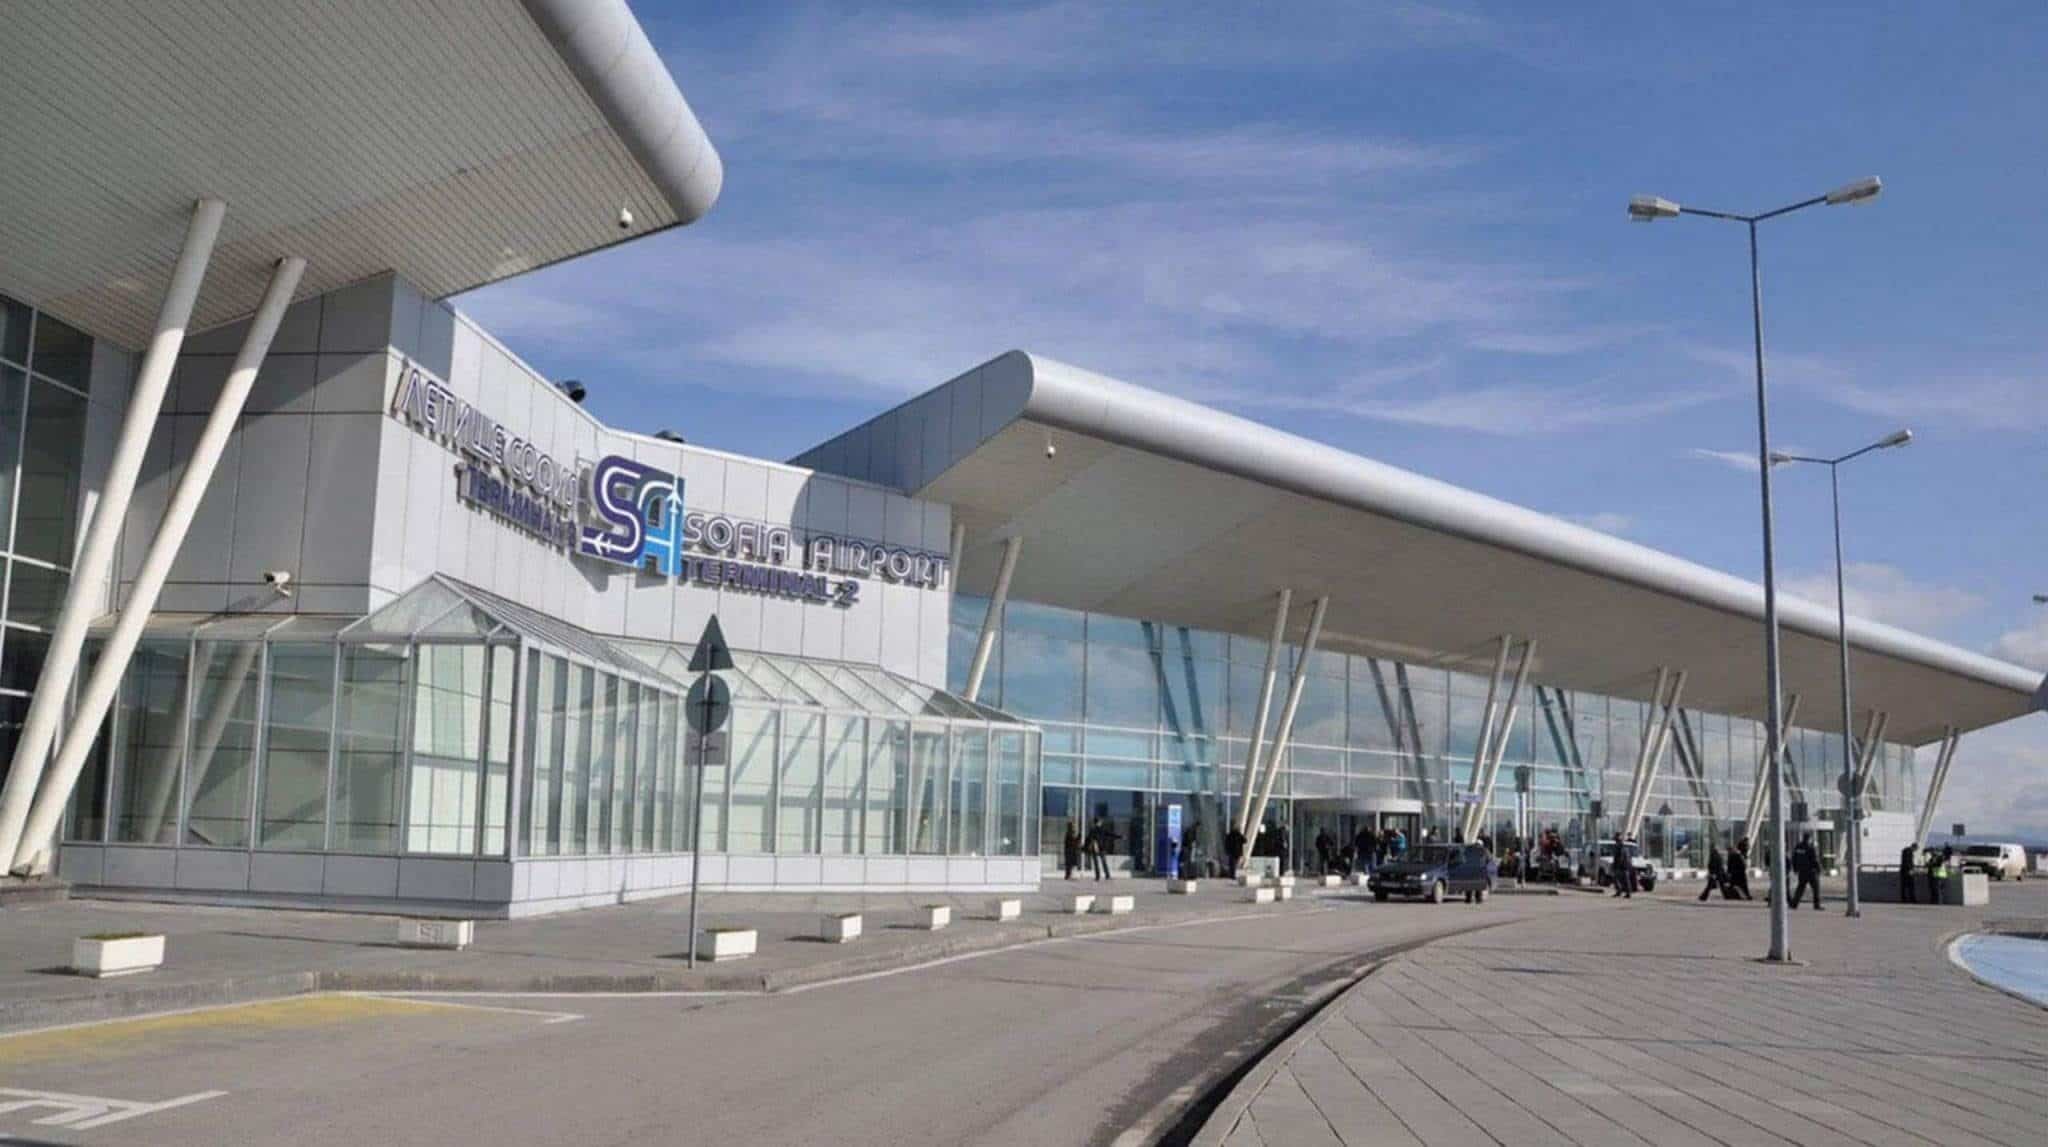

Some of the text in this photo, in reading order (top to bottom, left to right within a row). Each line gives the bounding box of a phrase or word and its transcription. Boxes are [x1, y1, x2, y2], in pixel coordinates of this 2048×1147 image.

[683, 513, 949, 588] SOFIA AIRPORT
[684, 557, 861, 604] TERMINAL 2
